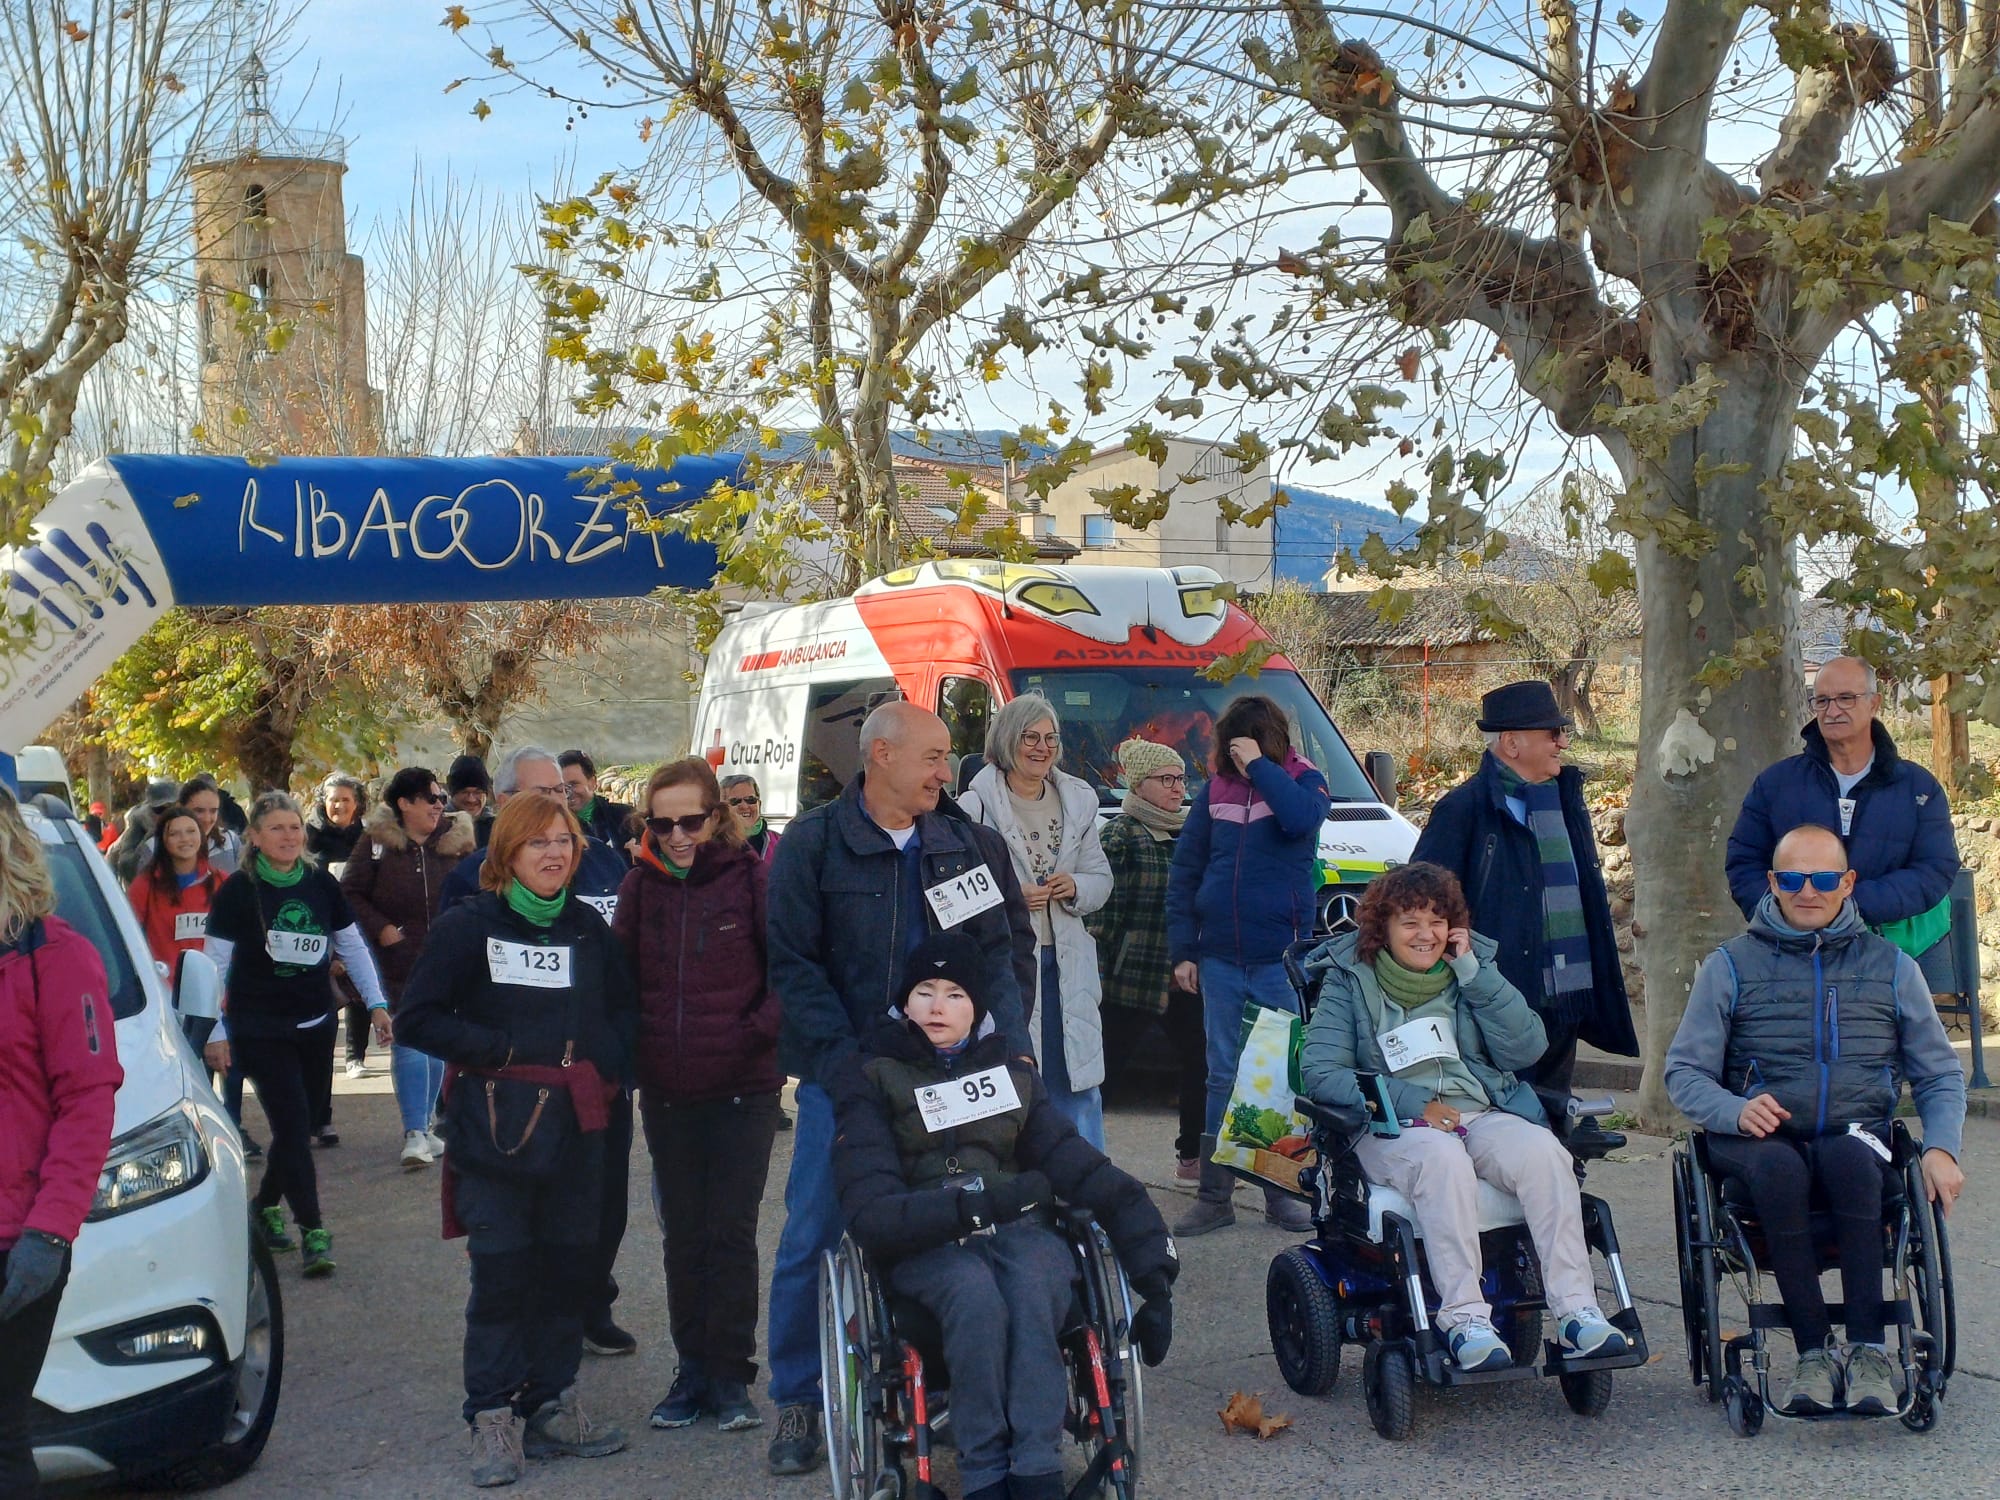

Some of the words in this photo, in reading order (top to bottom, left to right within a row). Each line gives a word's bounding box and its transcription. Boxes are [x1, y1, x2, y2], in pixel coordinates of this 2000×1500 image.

[239, 478, 665, 569] RIBAGORZA
[779, 640, 847, 666] AMBULANCIA
[730, 740, 760, 766] Cruz
[763, 735, 795, 770] Roja
[1318, 842, 1368, 854] Roja
[956, 872, 989, 901] 119
[292, 937, 320, 953] 180
[519, 949, 561, 972] 123
[1430, 1023, 1443, 1042] 1
[962, 1075, 997, 1103] 95
